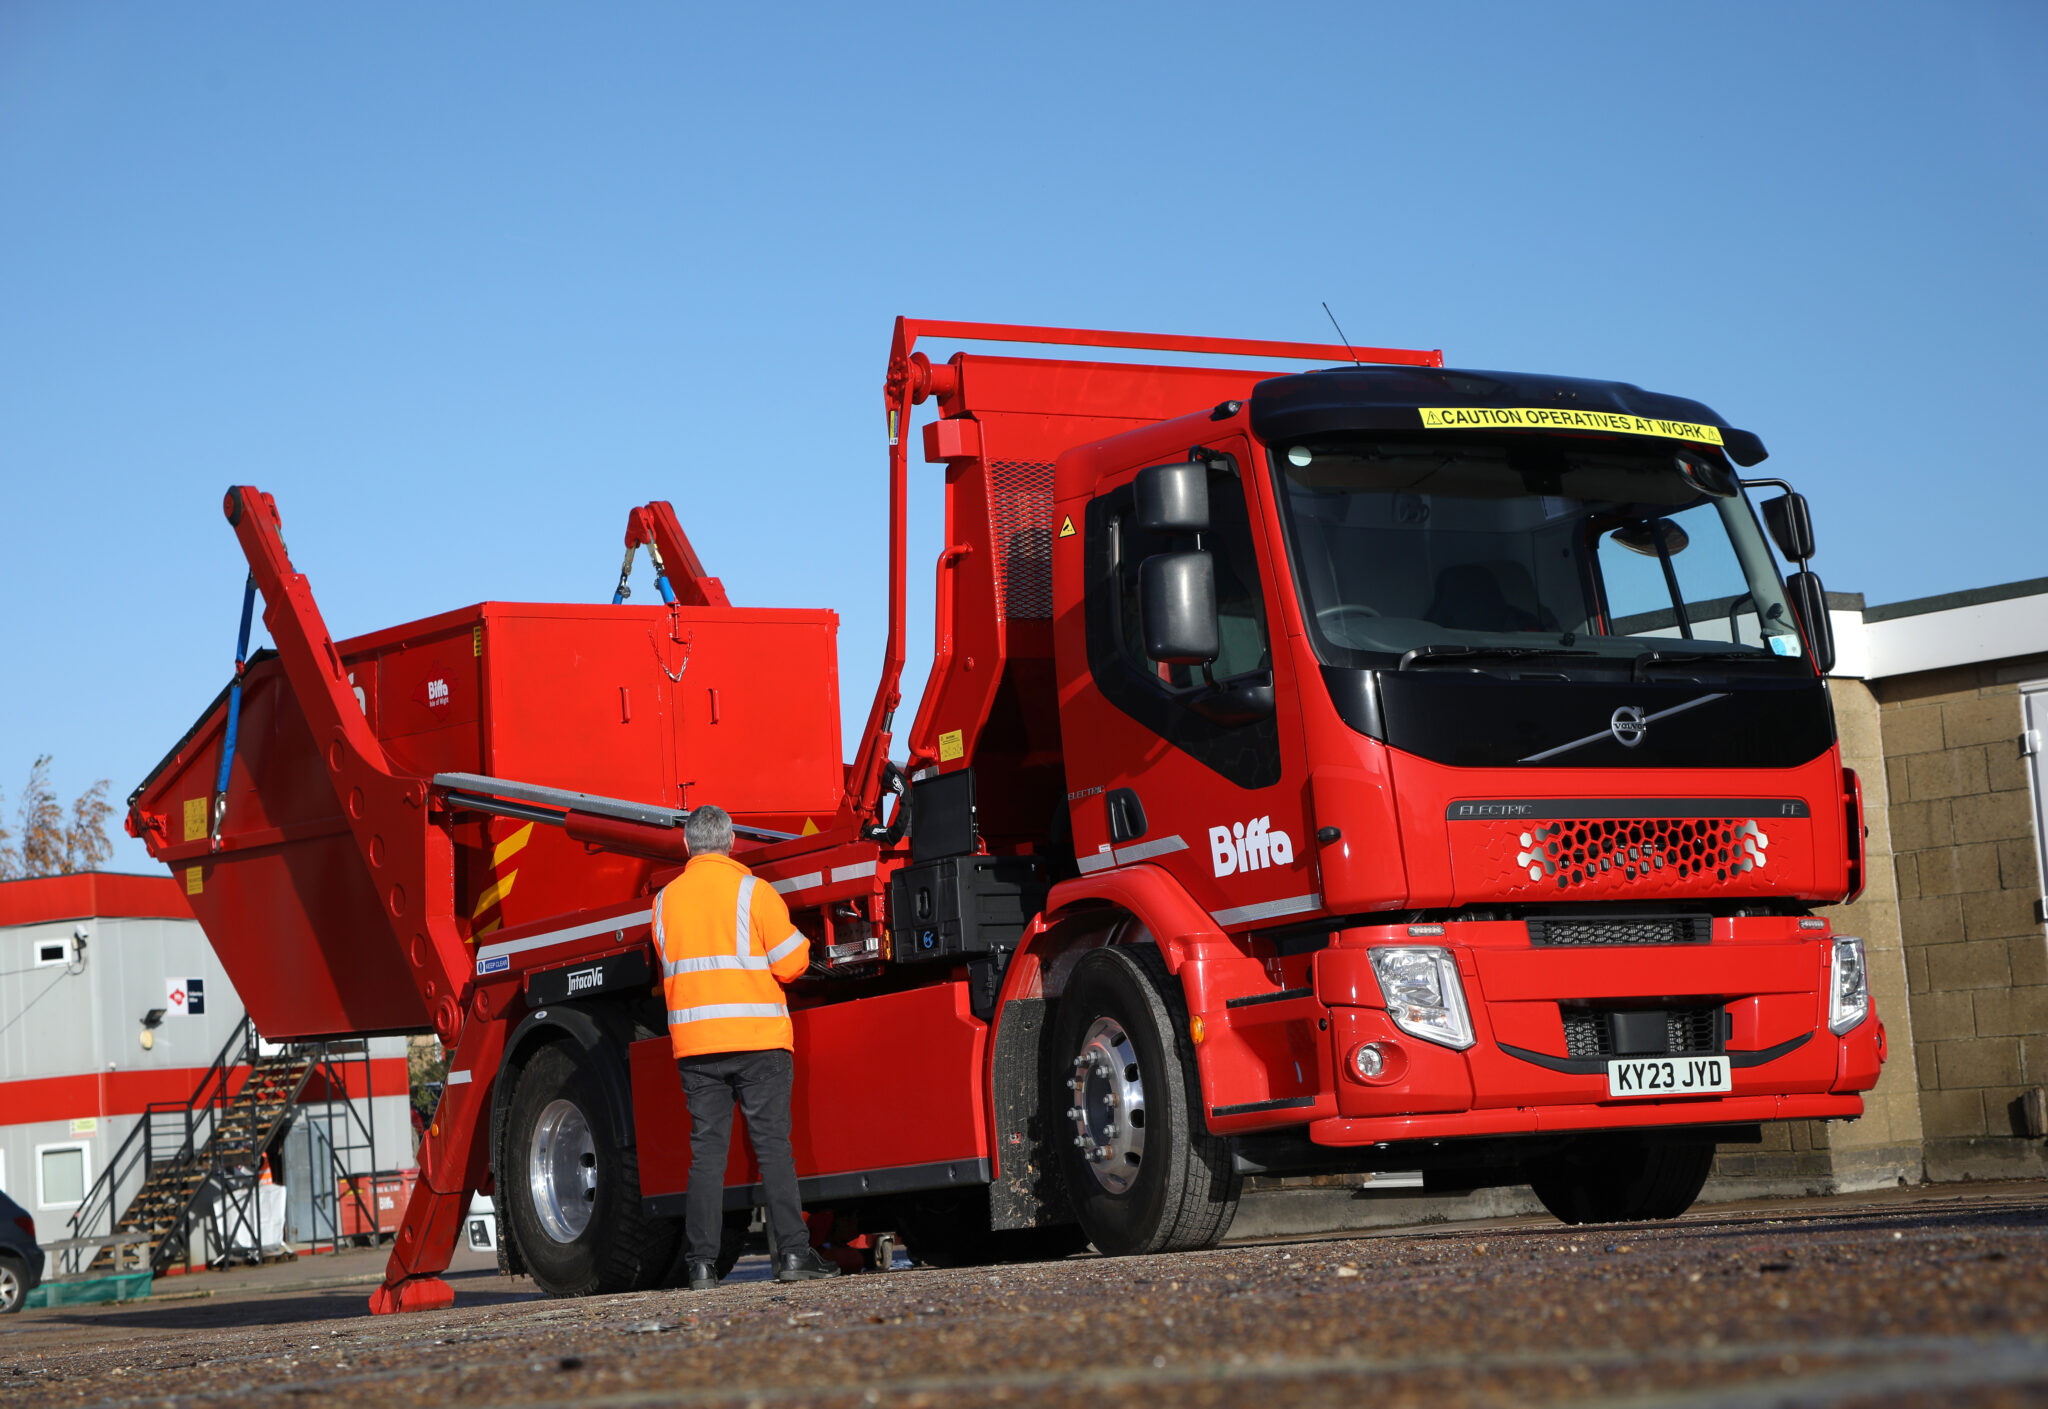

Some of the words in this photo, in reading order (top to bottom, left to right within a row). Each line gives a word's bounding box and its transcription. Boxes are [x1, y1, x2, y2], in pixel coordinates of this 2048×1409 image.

[1441, 409, 1522, 425] CAUTION
[1525, 410, 1632, 430] OPERATIVES
[1635, 417, 1654, 432] AT
[1657, 420, 1706, 440] WORK
[428, 679, 448, 699] Biffa
[1614, 722, 1643, 730] VOLVO
[1067, 785, 1105, 801] ELECTRIC
[1459, 804, 1532, 816] ELECTRIC
[1781, 803, 1801, 815] FE
[1208, 815, 1294, 878] Biffa
[485, 962, 496, 970] KEEP
[495, 959, 508, 968] CLEAR
[1618, 1062, 1675, 1090] KY23
[1682, 1060, 1722, 1087] JYD
